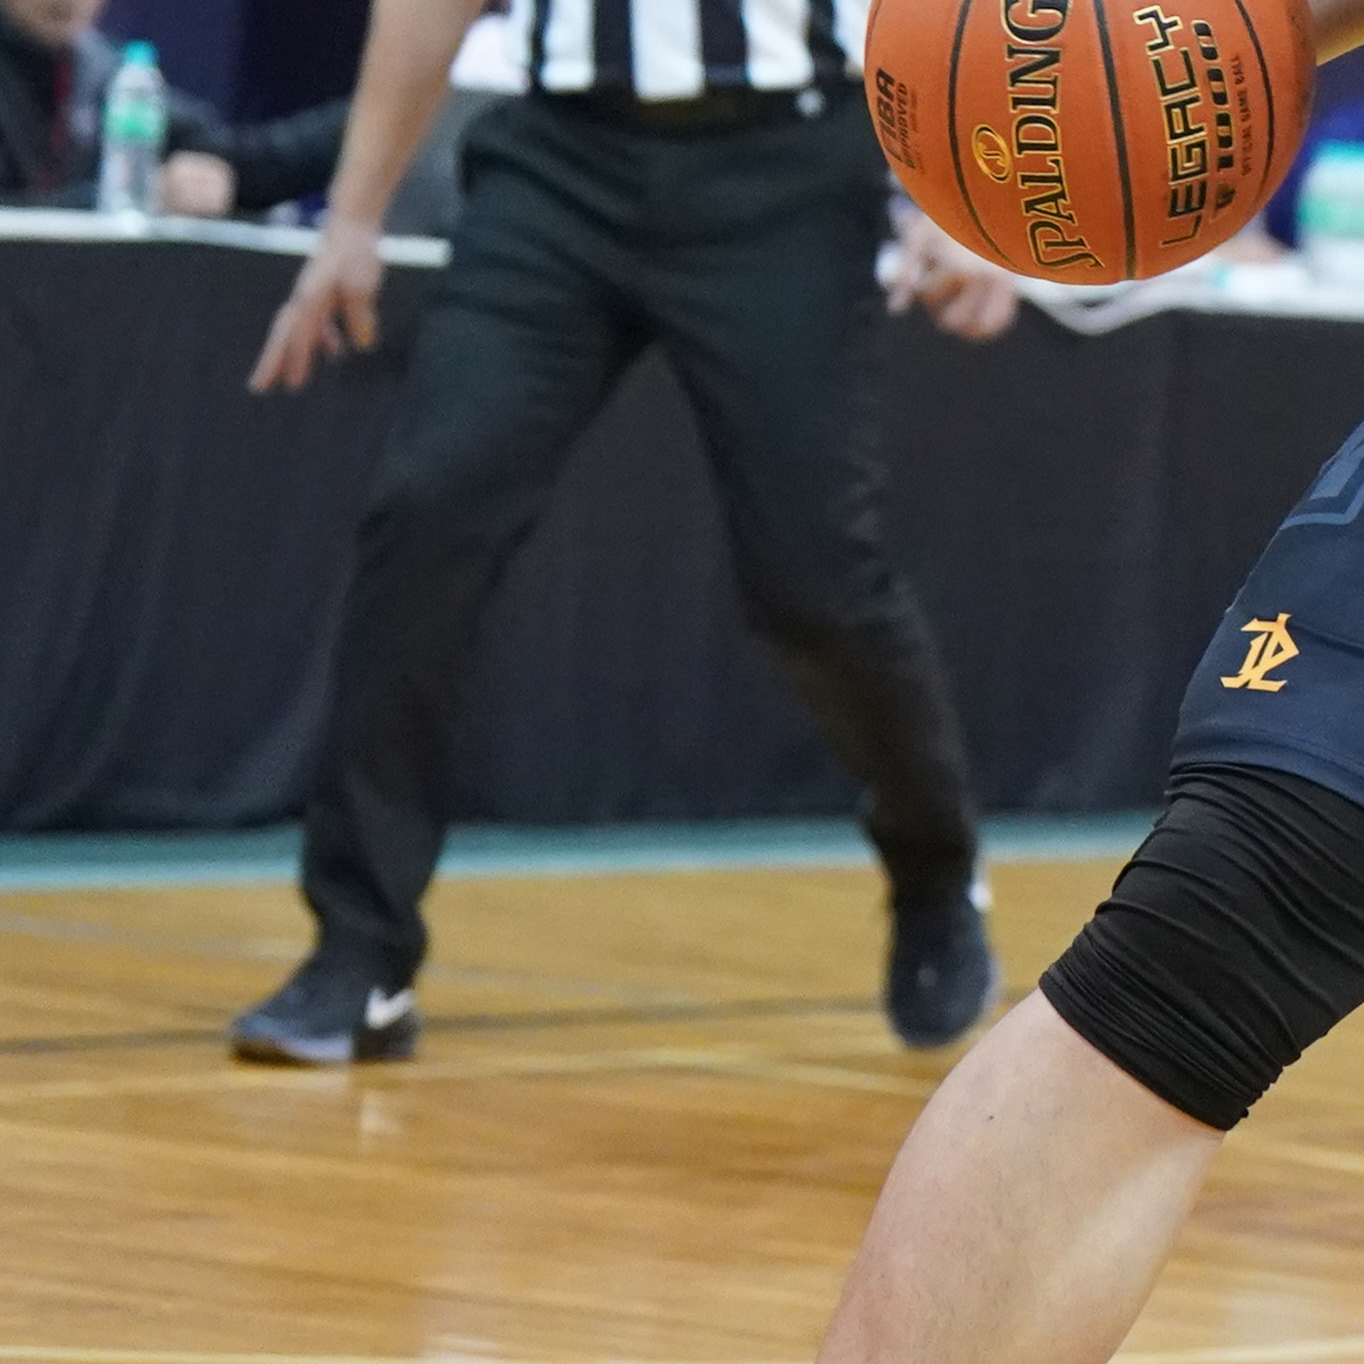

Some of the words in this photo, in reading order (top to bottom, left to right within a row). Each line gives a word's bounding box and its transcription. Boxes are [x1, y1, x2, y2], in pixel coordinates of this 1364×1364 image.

[1231, 54, 1247, 86] BALL
[1237, 88, 1252, 123] GAME
[1132, 4, 1212, 249] LEGACY
